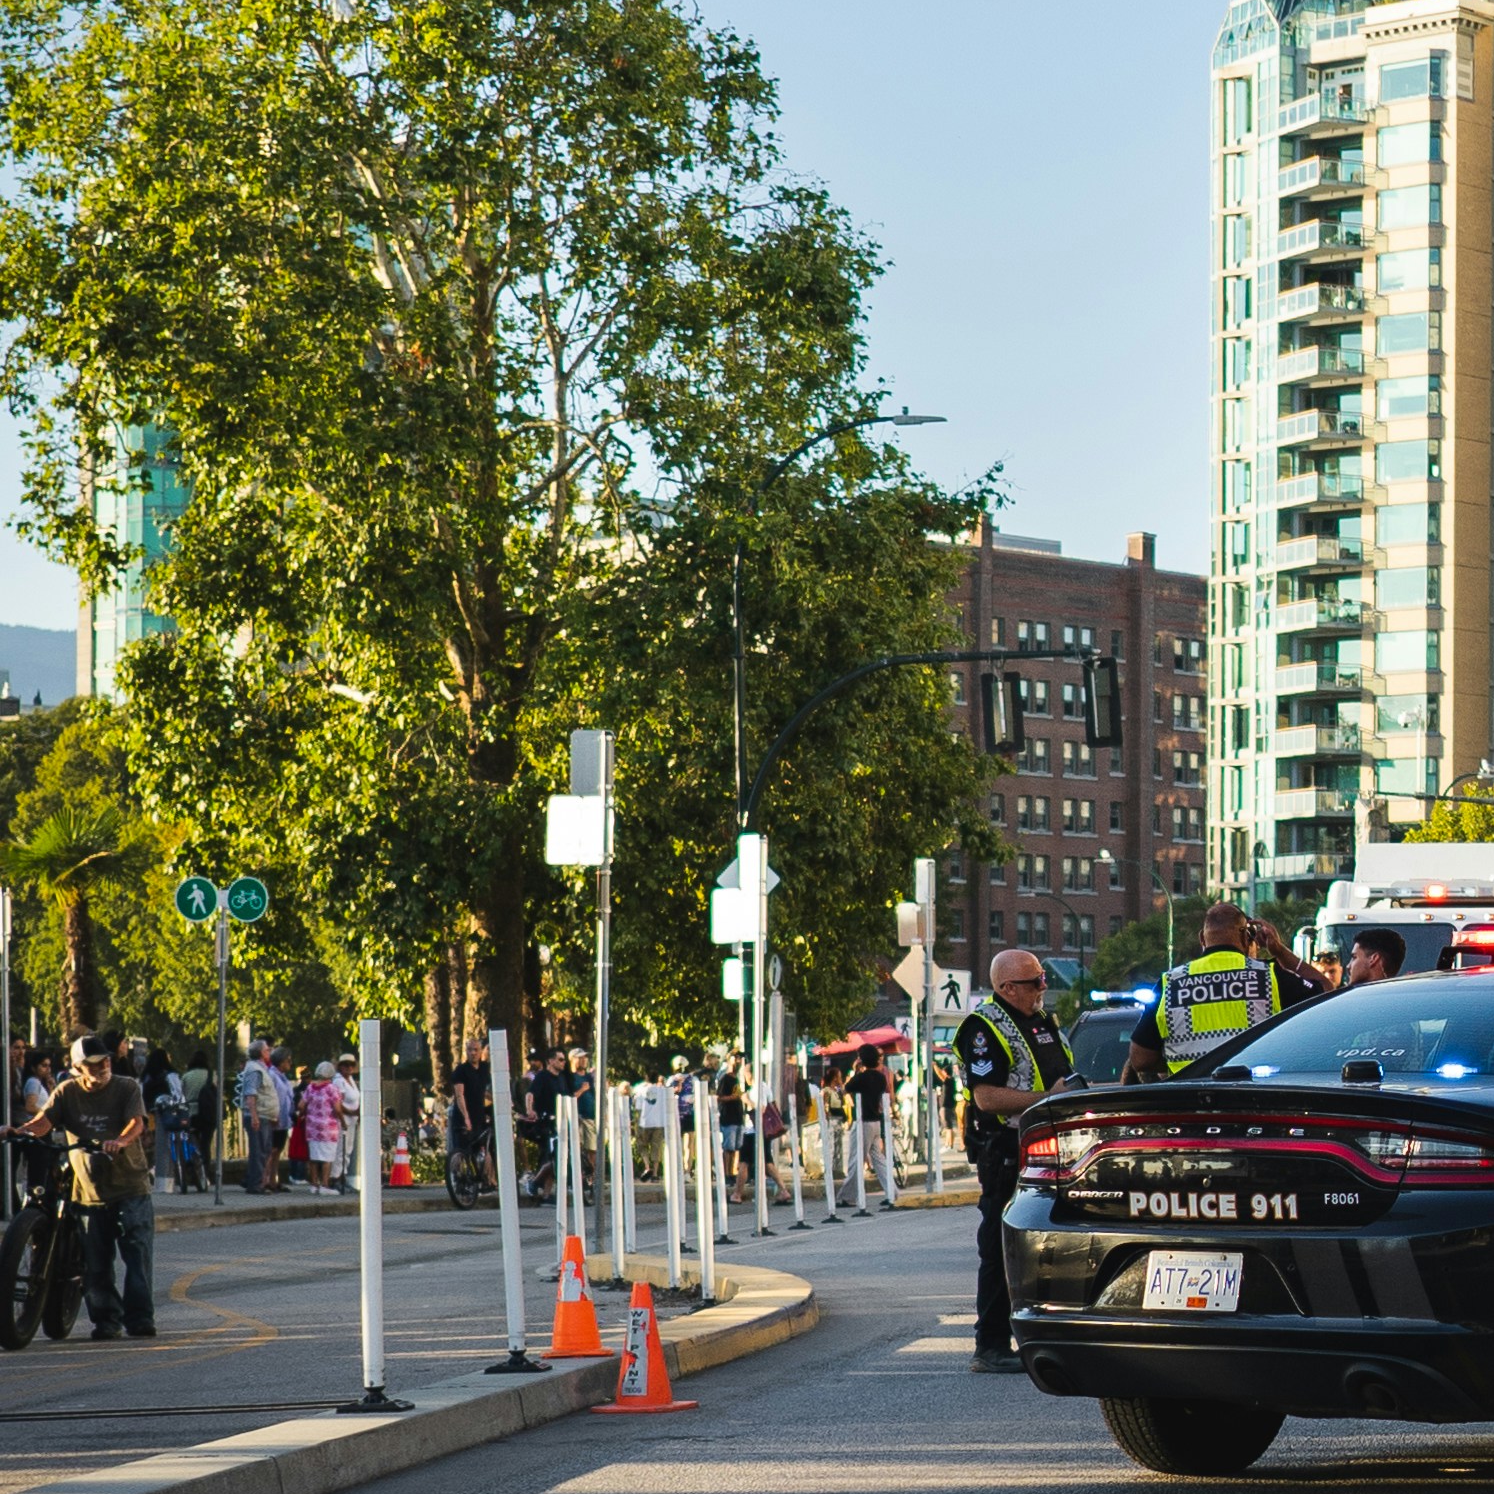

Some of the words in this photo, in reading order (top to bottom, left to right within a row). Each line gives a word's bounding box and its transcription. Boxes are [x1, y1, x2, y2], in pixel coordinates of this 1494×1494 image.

[1178, 970, 1258, 987] VANCOUVER
[1177, 981, 1260, 1005] POLICE
[1336, 1047, 1406, 1058] vpd.ca
[1129, 1126, 1305, 1136] DODGE
[1129, 1192, 1237, 1219] POLICE
[1251, 1193, 1298, 1219] 911
[1324, 1193, 1360, 1205] F8061
[630, 1310, 644, 1335] WET
